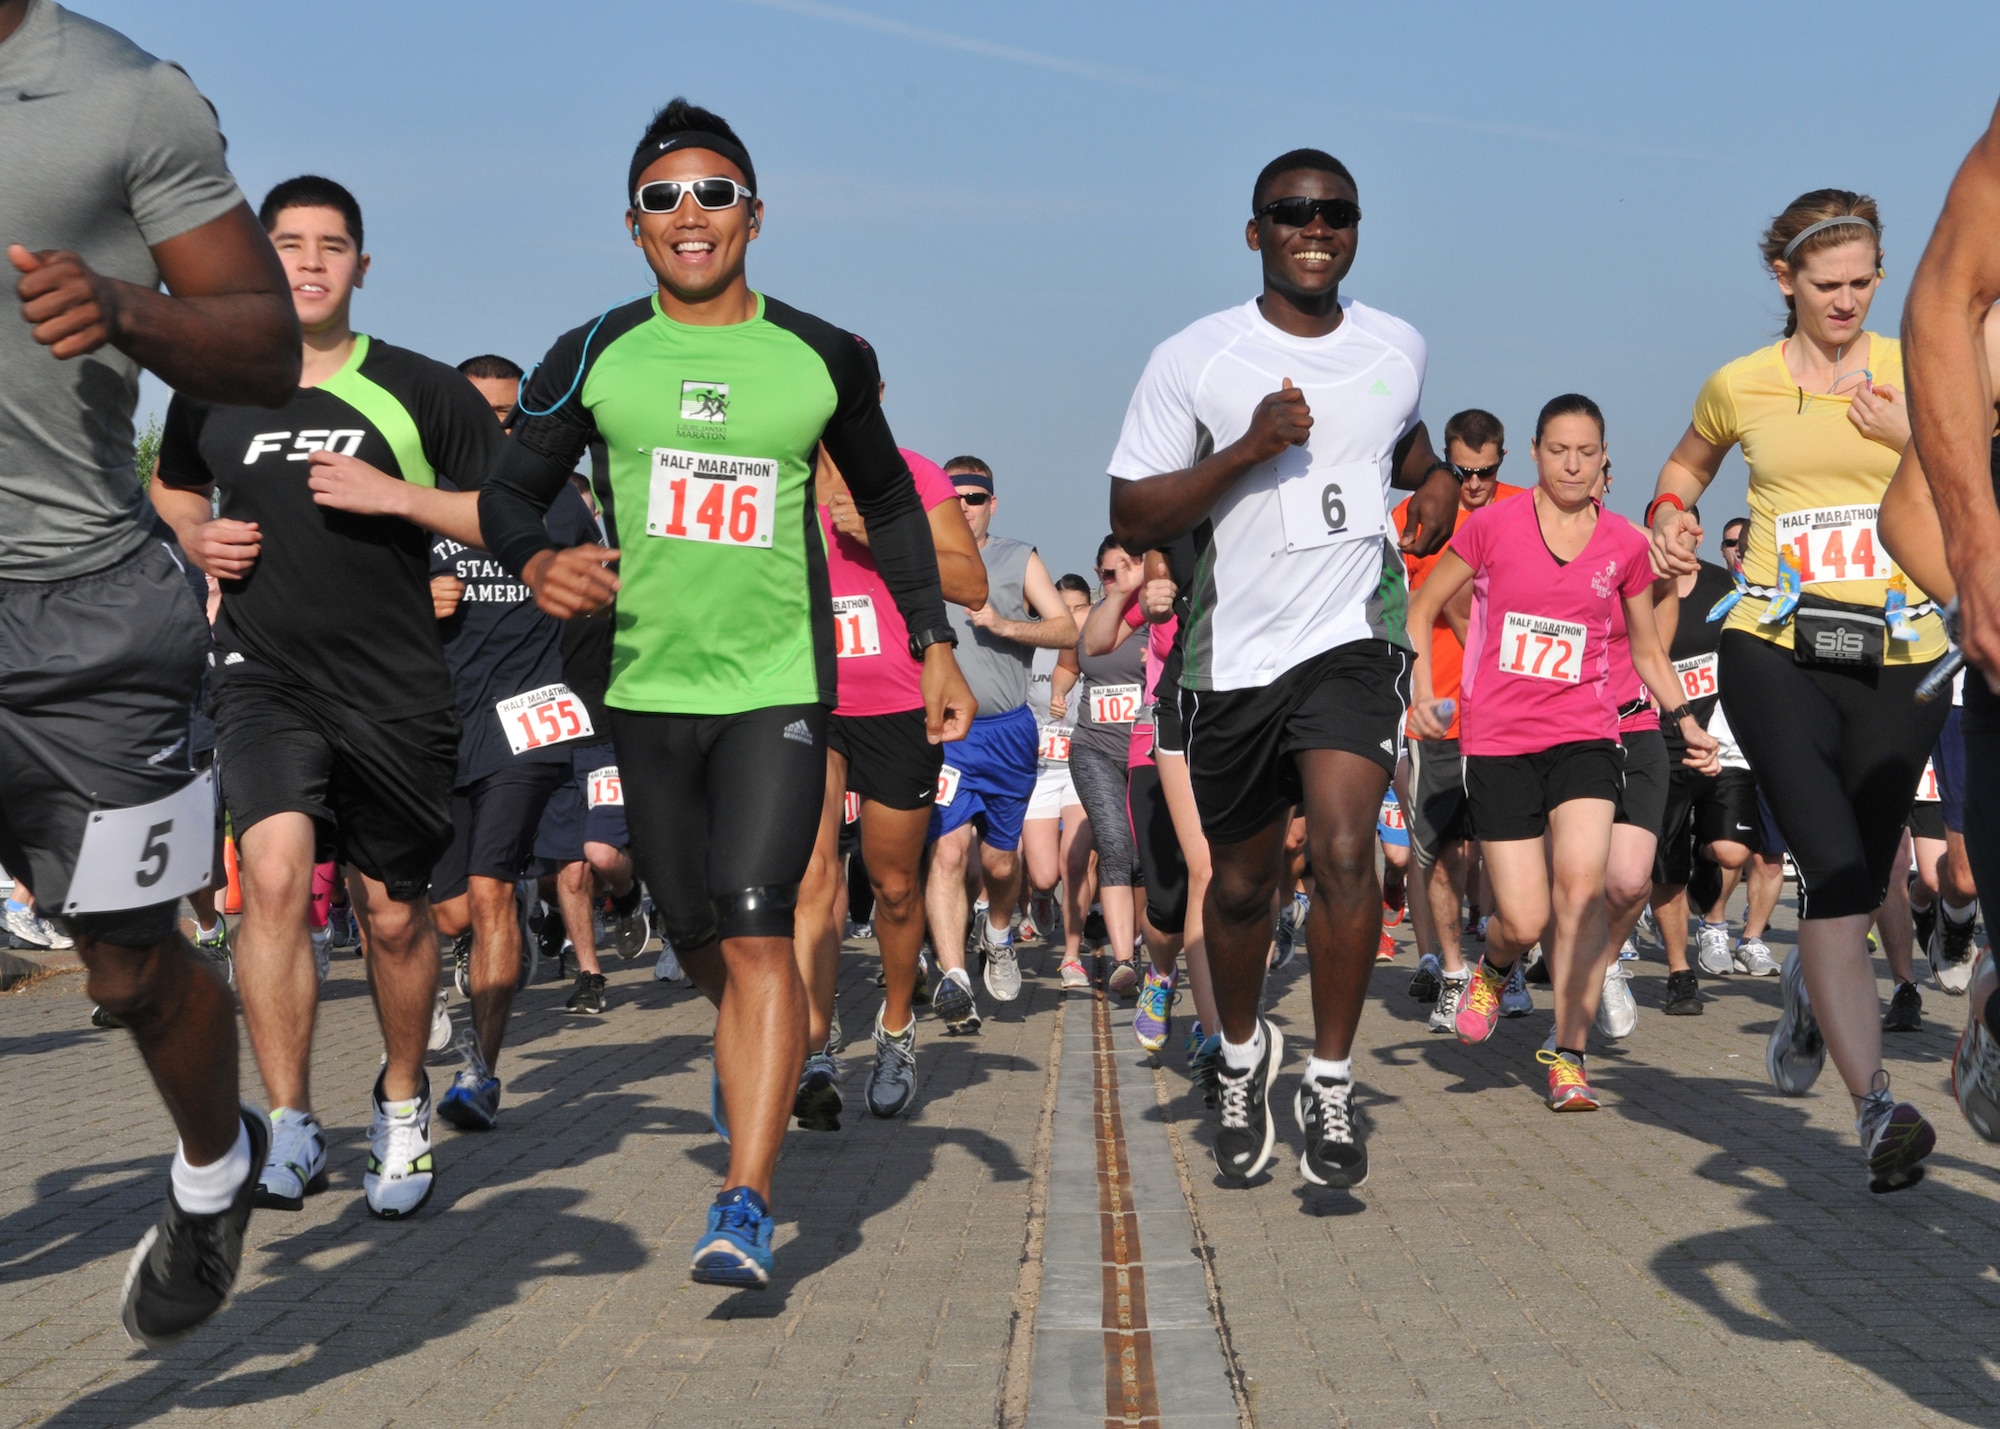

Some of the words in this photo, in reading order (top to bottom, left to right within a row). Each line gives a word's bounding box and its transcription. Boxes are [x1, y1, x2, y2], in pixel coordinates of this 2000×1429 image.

[676, 430, 727, 440] MARATON
[660, 453, 694, 470] HALF
[698, 459, 771, 477] MARATHON
[666, 477, 758, 542] 146
[1321, 483, 1346, 529] 6
[1782, 513, 1811, 528] HALF
[1794, 528, 1875, 582] 144
[1509, 616, 1532, 628] HALF
[1534, 620, 1582, 636] MARATHON
[1511, 633, 1573, 679] 172
[1678, 655, 1714, 670] MARATHON
[1106, 686, 1138, 694] MARATHON
[1684, 666, 1715, 697] 85
[503, 698, 526, 713] HALF
[527, 686, 572, 704] MARATHO
[1098, 696, 1136, 722] 102
[517, 699, 581, 748] 155
[135, 818, 174, 888] 5
